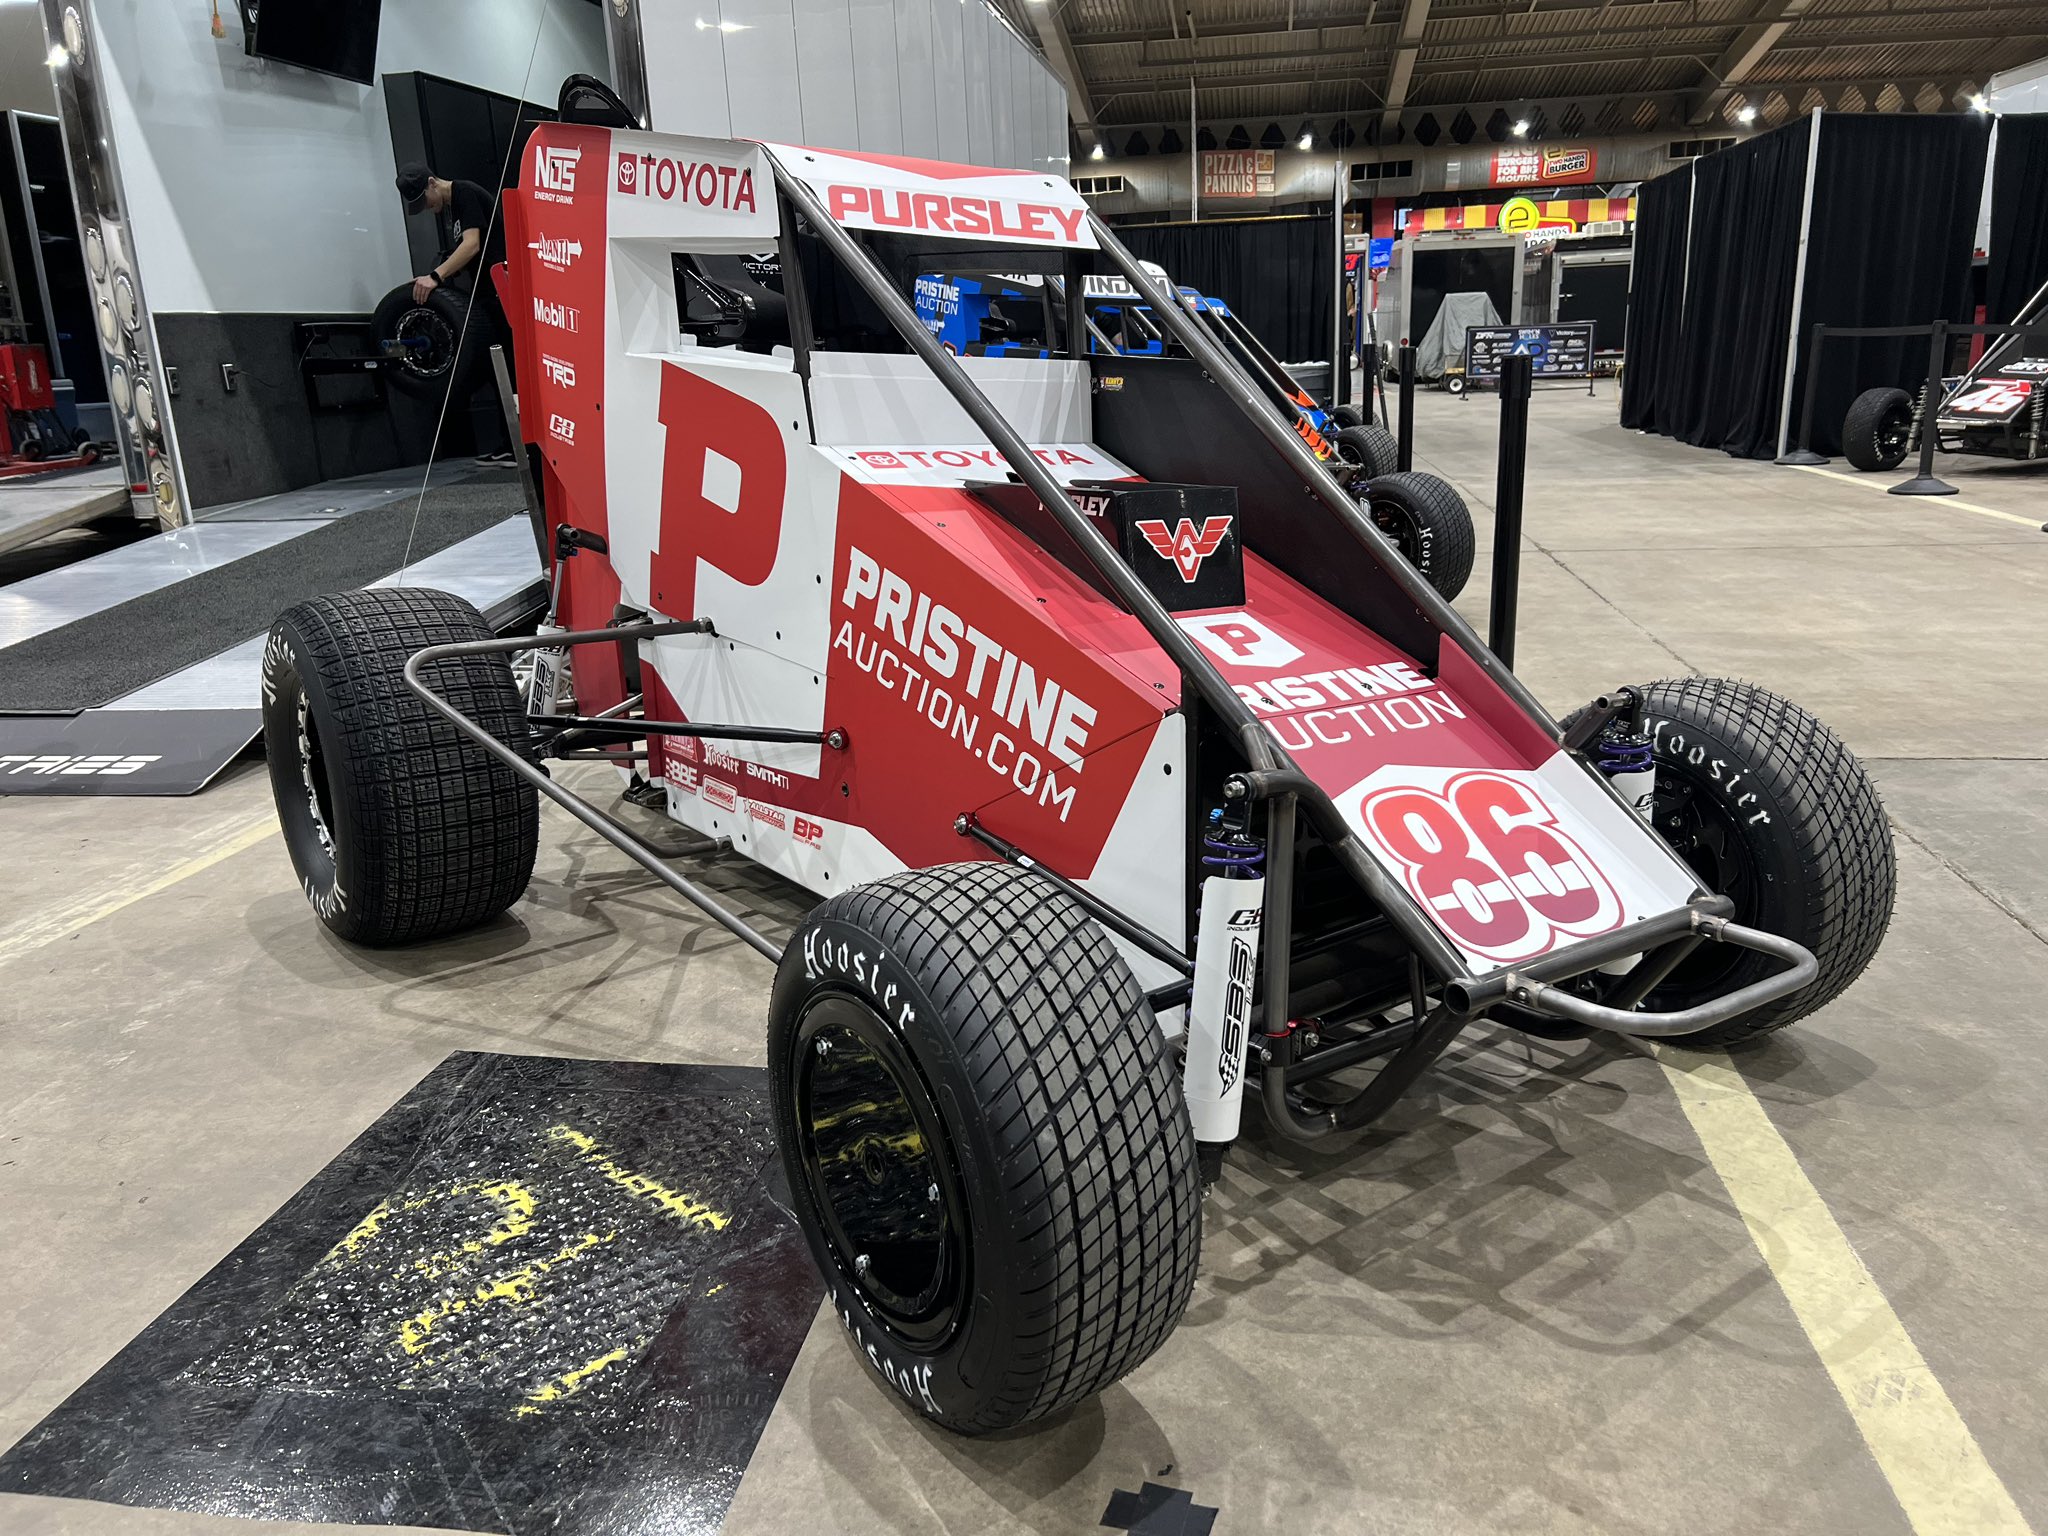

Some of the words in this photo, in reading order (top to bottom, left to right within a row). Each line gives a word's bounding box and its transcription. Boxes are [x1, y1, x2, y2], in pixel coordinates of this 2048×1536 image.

[535, 146, 580, 192] NOS
[1204, 154, 1244, 174] PIZZA
[1246, 157, 1254, 174] &
[1497, 166, 1517, 175] FOR
[1520, 165, 1539, 174] BIG
[1549, 161, 1585, 173] BURGER
[534, 191, 556, 202] ENERGY
[555, 194, 574, 205] DRINK
[640, 156, 756, 214] TOYOTA
[1204, 174, 1254, 193] PANINIS
[827, 184, 1085, 243] PURSLEY
[1533, 228, 1567, 238] HANDS
[915, 279, 960, 302] PRISTINE
[915, 295, 959, 315] AUCTION
[533, 297, 566, 329] Mobil
[542, 358, 576, 389] TRD
[898, 449, 1094, 468] TOYTA
[650, 360, 787, 623] P
[1419, 526, 1433, 575] Hoosi
[1204, 623, 1264, 657] P
[842, 545, 1098, 775] PRISTINE
[1232, 661, 1435, 716] RISTINE
[834, 620, 1078, 823] AUCTION.COM
[1262, 690, 1468, 752] UCTION
[703, 741, 741, 775] Hoosier
[1643, 717, 1772, 825] Hoosier
[750, 801, 785, 821] ALLSTAR
[793, 815, 824, 841] BP
[1365, 773, 1616, 956] 86
[803, 926, 916, 1030] Hoosier
